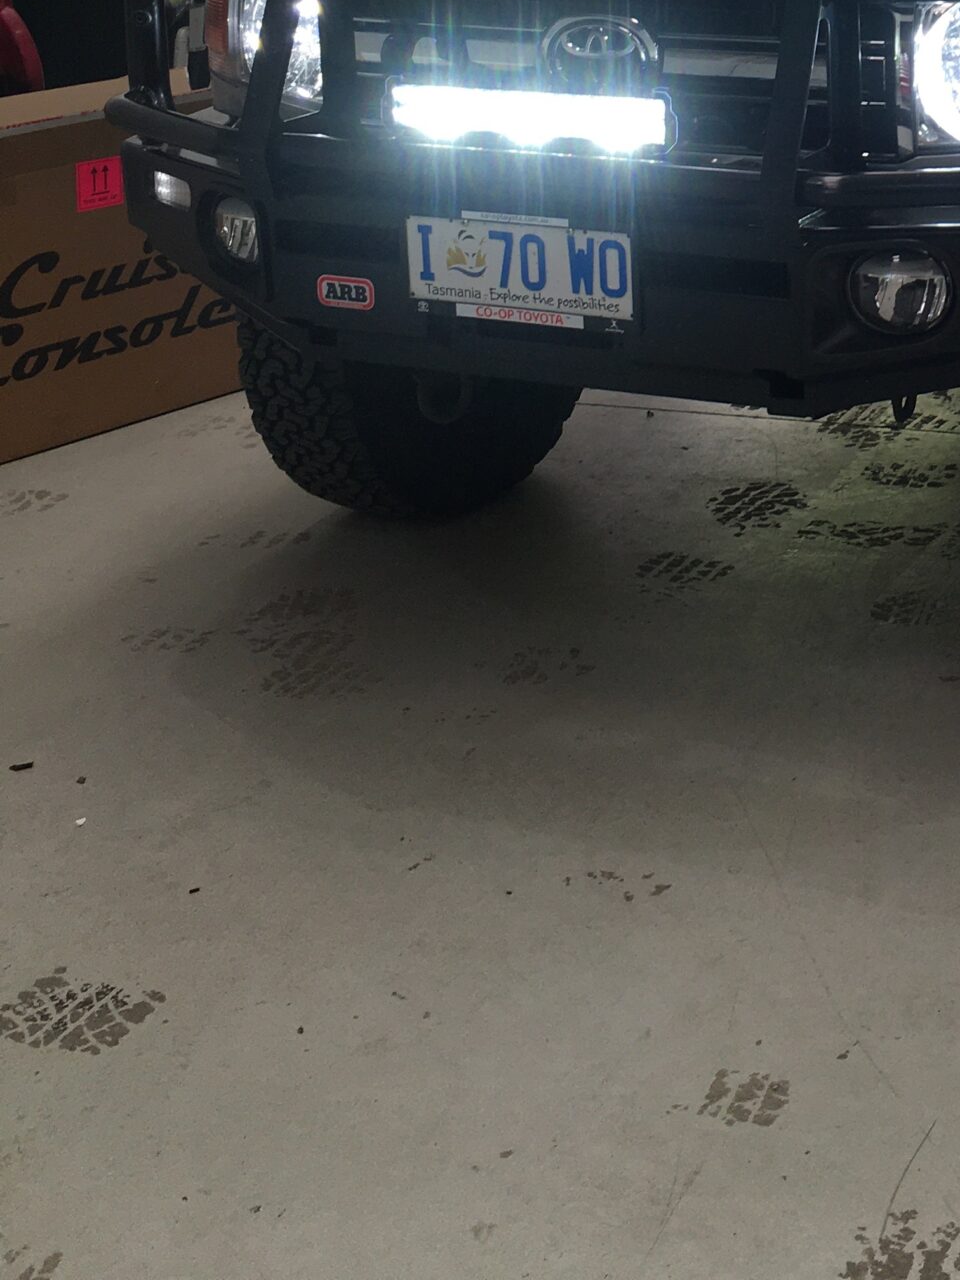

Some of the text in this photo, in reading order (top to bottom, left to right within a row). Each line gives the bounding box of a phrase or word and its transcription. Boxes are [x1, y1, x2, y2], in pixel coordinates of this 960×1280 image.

[417, 224, 628, 298] I 70 WO
[0, 239, 182, 319] Cruis
[325, 282, 368, 303] ARB
[425, 283, 481, 299] Tasmania
[490, 287, 529, 304] Explore
[532, 293, 554, 307] the
[556, 297, 620, 314] possibilities
[476, 306, 564, 325] CO-OP TOYOTA
